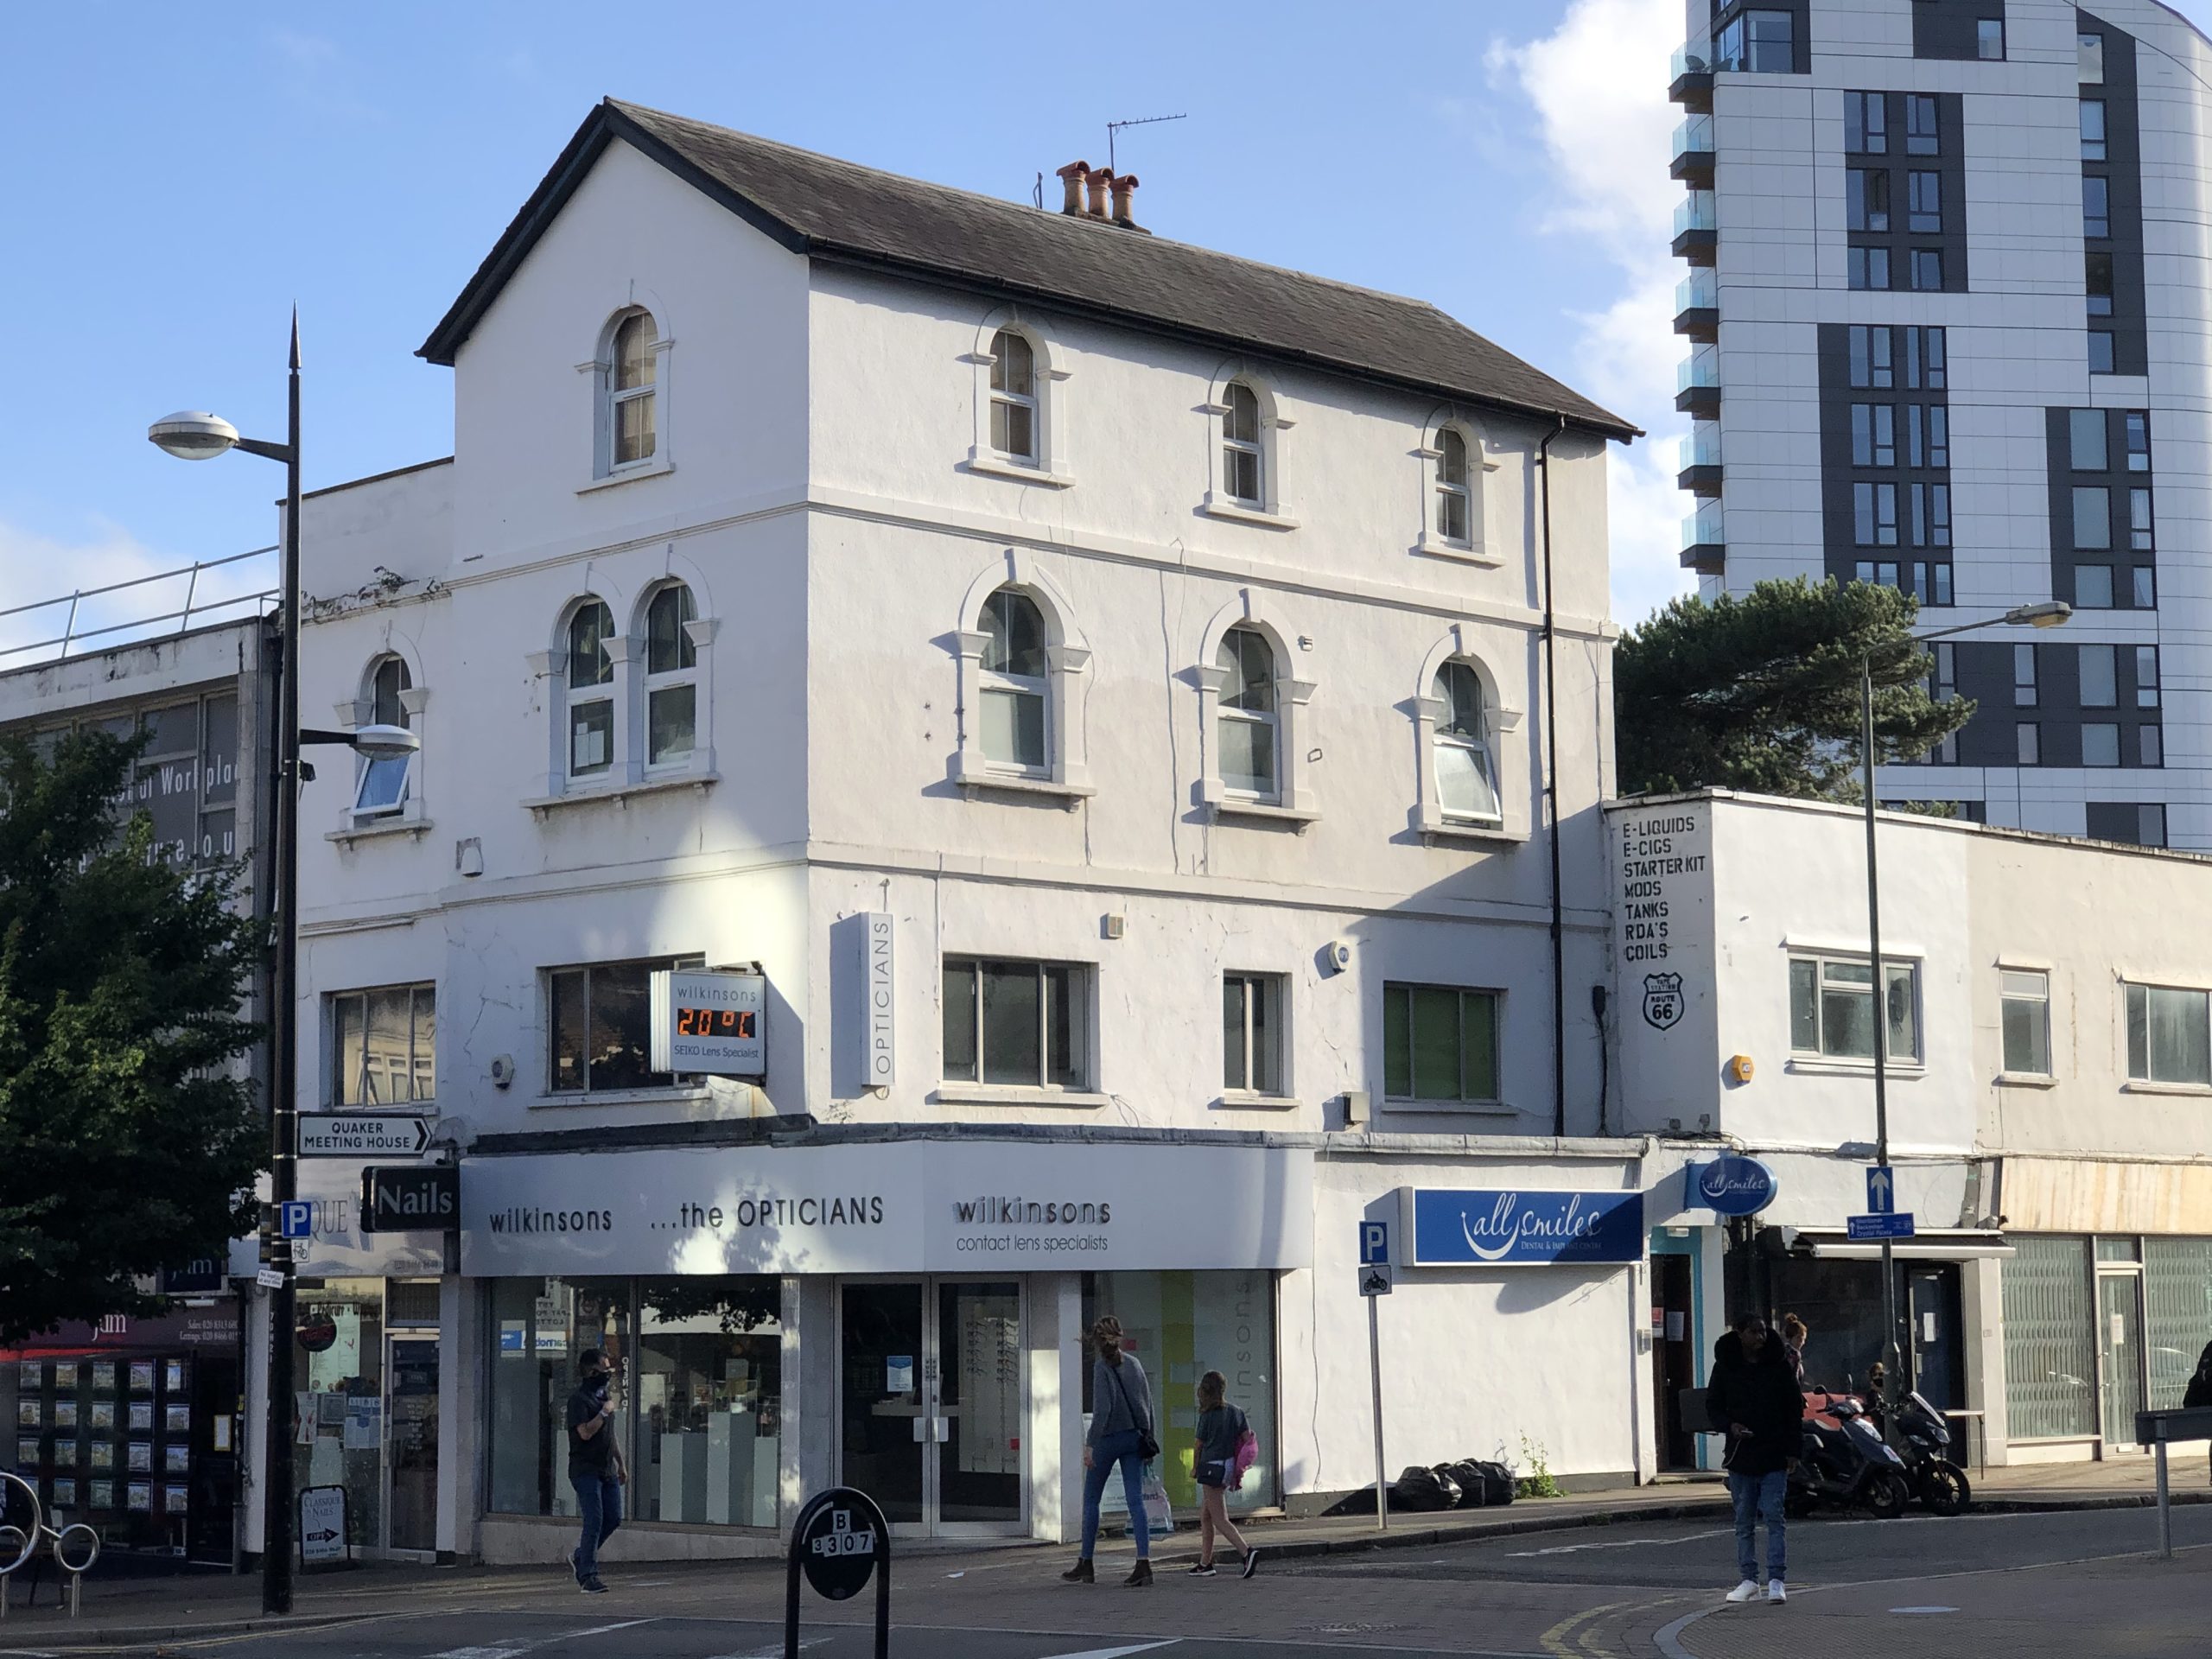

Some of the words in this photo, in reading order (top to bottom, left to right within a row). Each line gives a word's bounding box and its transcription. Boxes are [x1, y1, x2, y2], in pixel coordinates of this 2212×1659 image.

[1624, 817, 1694, 838] E-LIQUIDS
[1624, 838, 1671, 857] E-CIGS
[1624, 859, 1682, 877] STARTER
[1686, 855, 1706, 873] KIT
[1624, 881, 1662, 899] MODS
[1625, 902, 1669, 919] TANKS
[1625, 922, 1668, 940] RDA'S
[1626, 943, 1668, 962] COILS
[677, 986, 756, 1002] wilkinsons
[874, 922, 891, 1074] OPTICIANS
[1653, 1003, 1673, 1020] 66
[674, 1045, 700, 1056] SEIKO
[702, 1046, 721, 1058] Lens
[722, 1047, 759, 1059] Specialist
[332, 1122, 384, 1134] QUAKER
[304, 1136, 362, 1147] MEETING
[366, 1136, 410, 1147] HOUSE
[378, 1183, 453, 1215] Nails
[737, 1196, 883, 1227] OPTICIANS
[953, 1196, 1110, 1224] wilkinsons
[289, 1205, 308, 1235] P
[490, 1207, 612, 1234] wilkinsons
[957, 1235, 1010, 1251] contact
[1014, 1234, 1039, 1251] lens
[1044, 1234, 1108, 1254] specialists
[1366, 1225, 1384, 1261] P
[1521, 1241, 1544, 1250] DENTAL
[836, 1513, 846, 1529] B
